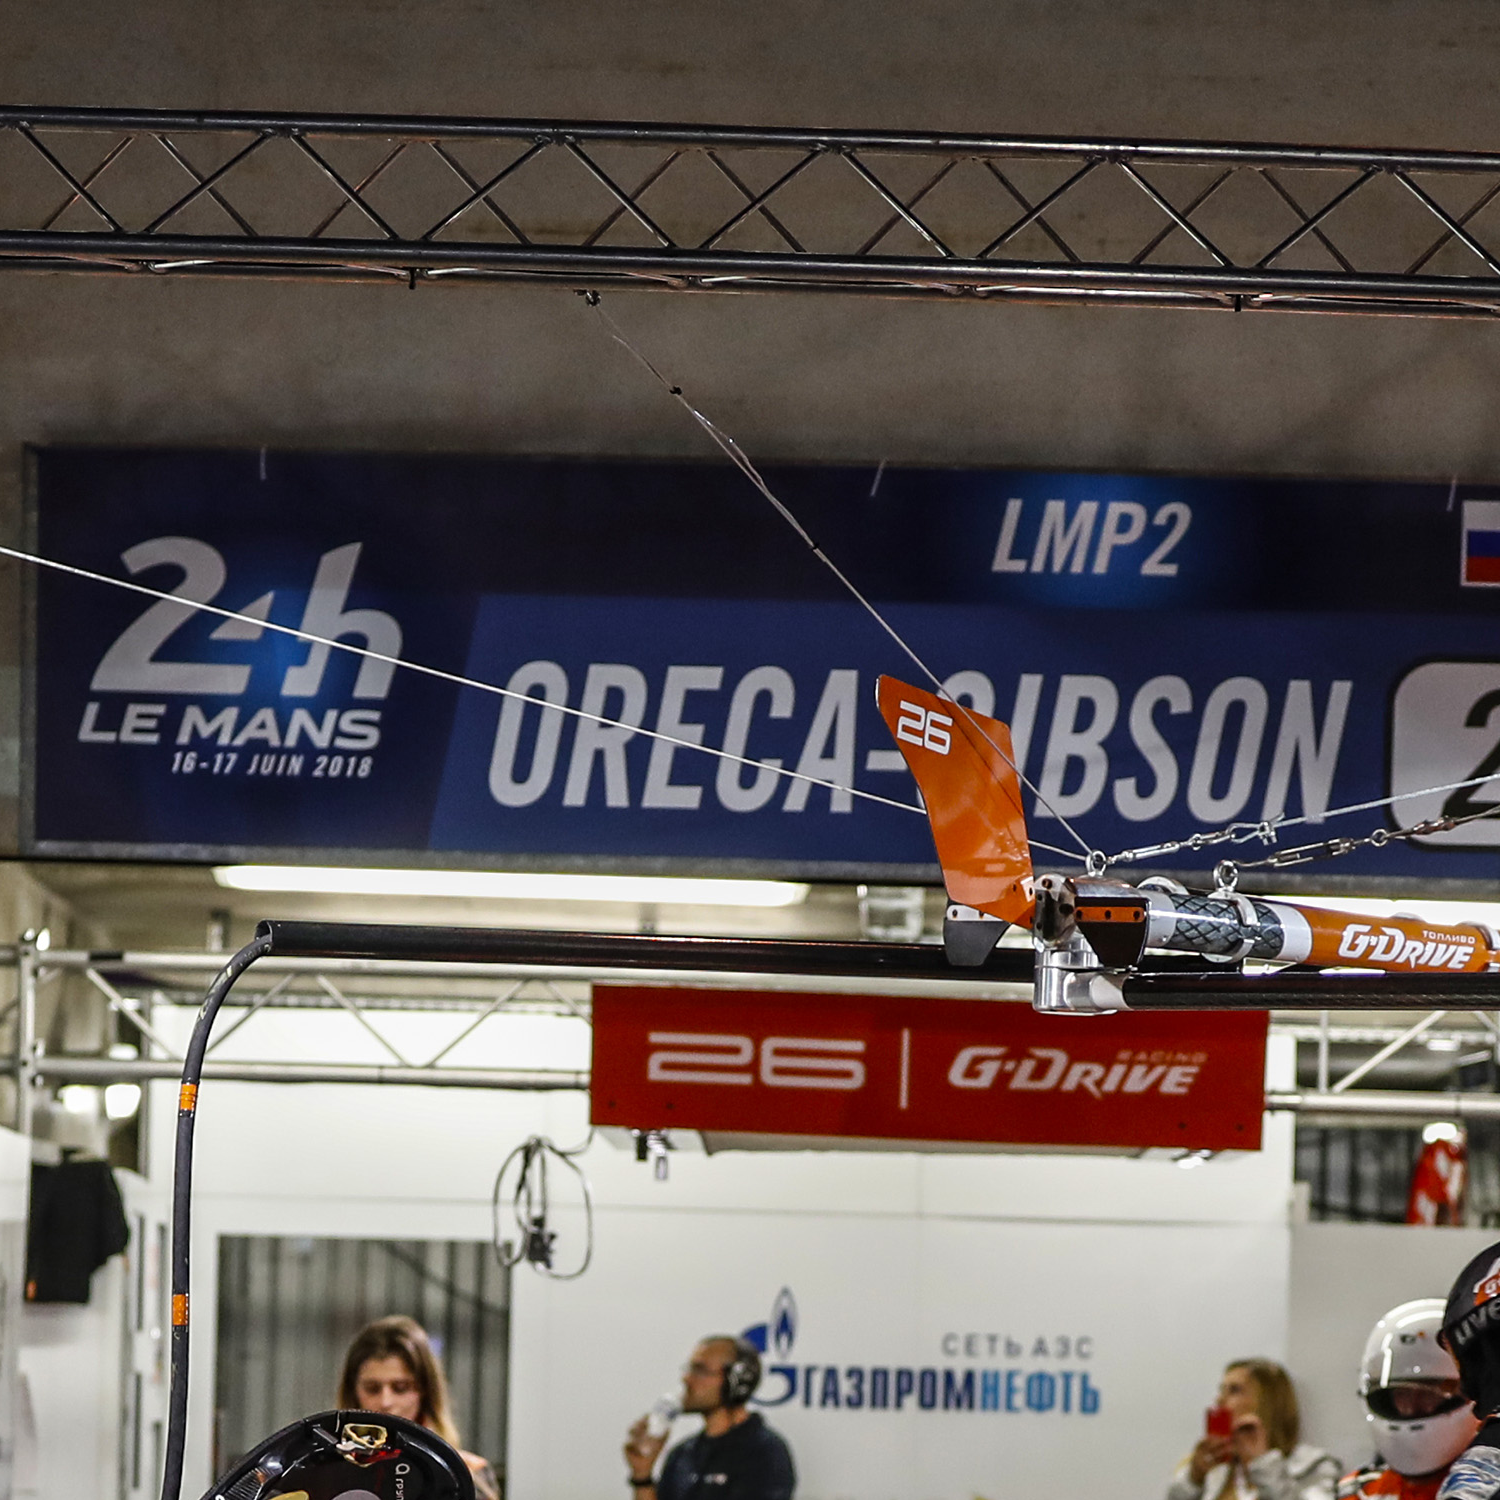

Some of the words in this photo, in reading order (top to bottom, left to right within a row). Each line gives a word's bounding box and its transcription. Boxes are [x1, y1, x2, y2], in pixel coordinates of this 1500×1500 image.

[991, 498, 1192, 578] LMP2
[89, 535, 404, 701] 24h
[77, 702, 167, 745] LE
[175, 706, 383, 752] MANS
[896, 699, 954, 756] 26
[171, 751, 237, 776] 16-17
[246, 753, 305, 778] JUIN
[312, 754, 374, 780] 2018
[646, 1031, 867, 1091] 26
[941, 1332, 1022, 1358] СЕТЬ
[1031, 1335, 1094, 1359] АЗС
[802, 1366, 1101, 1415] ГАЗПРОМНЕФТЬ
